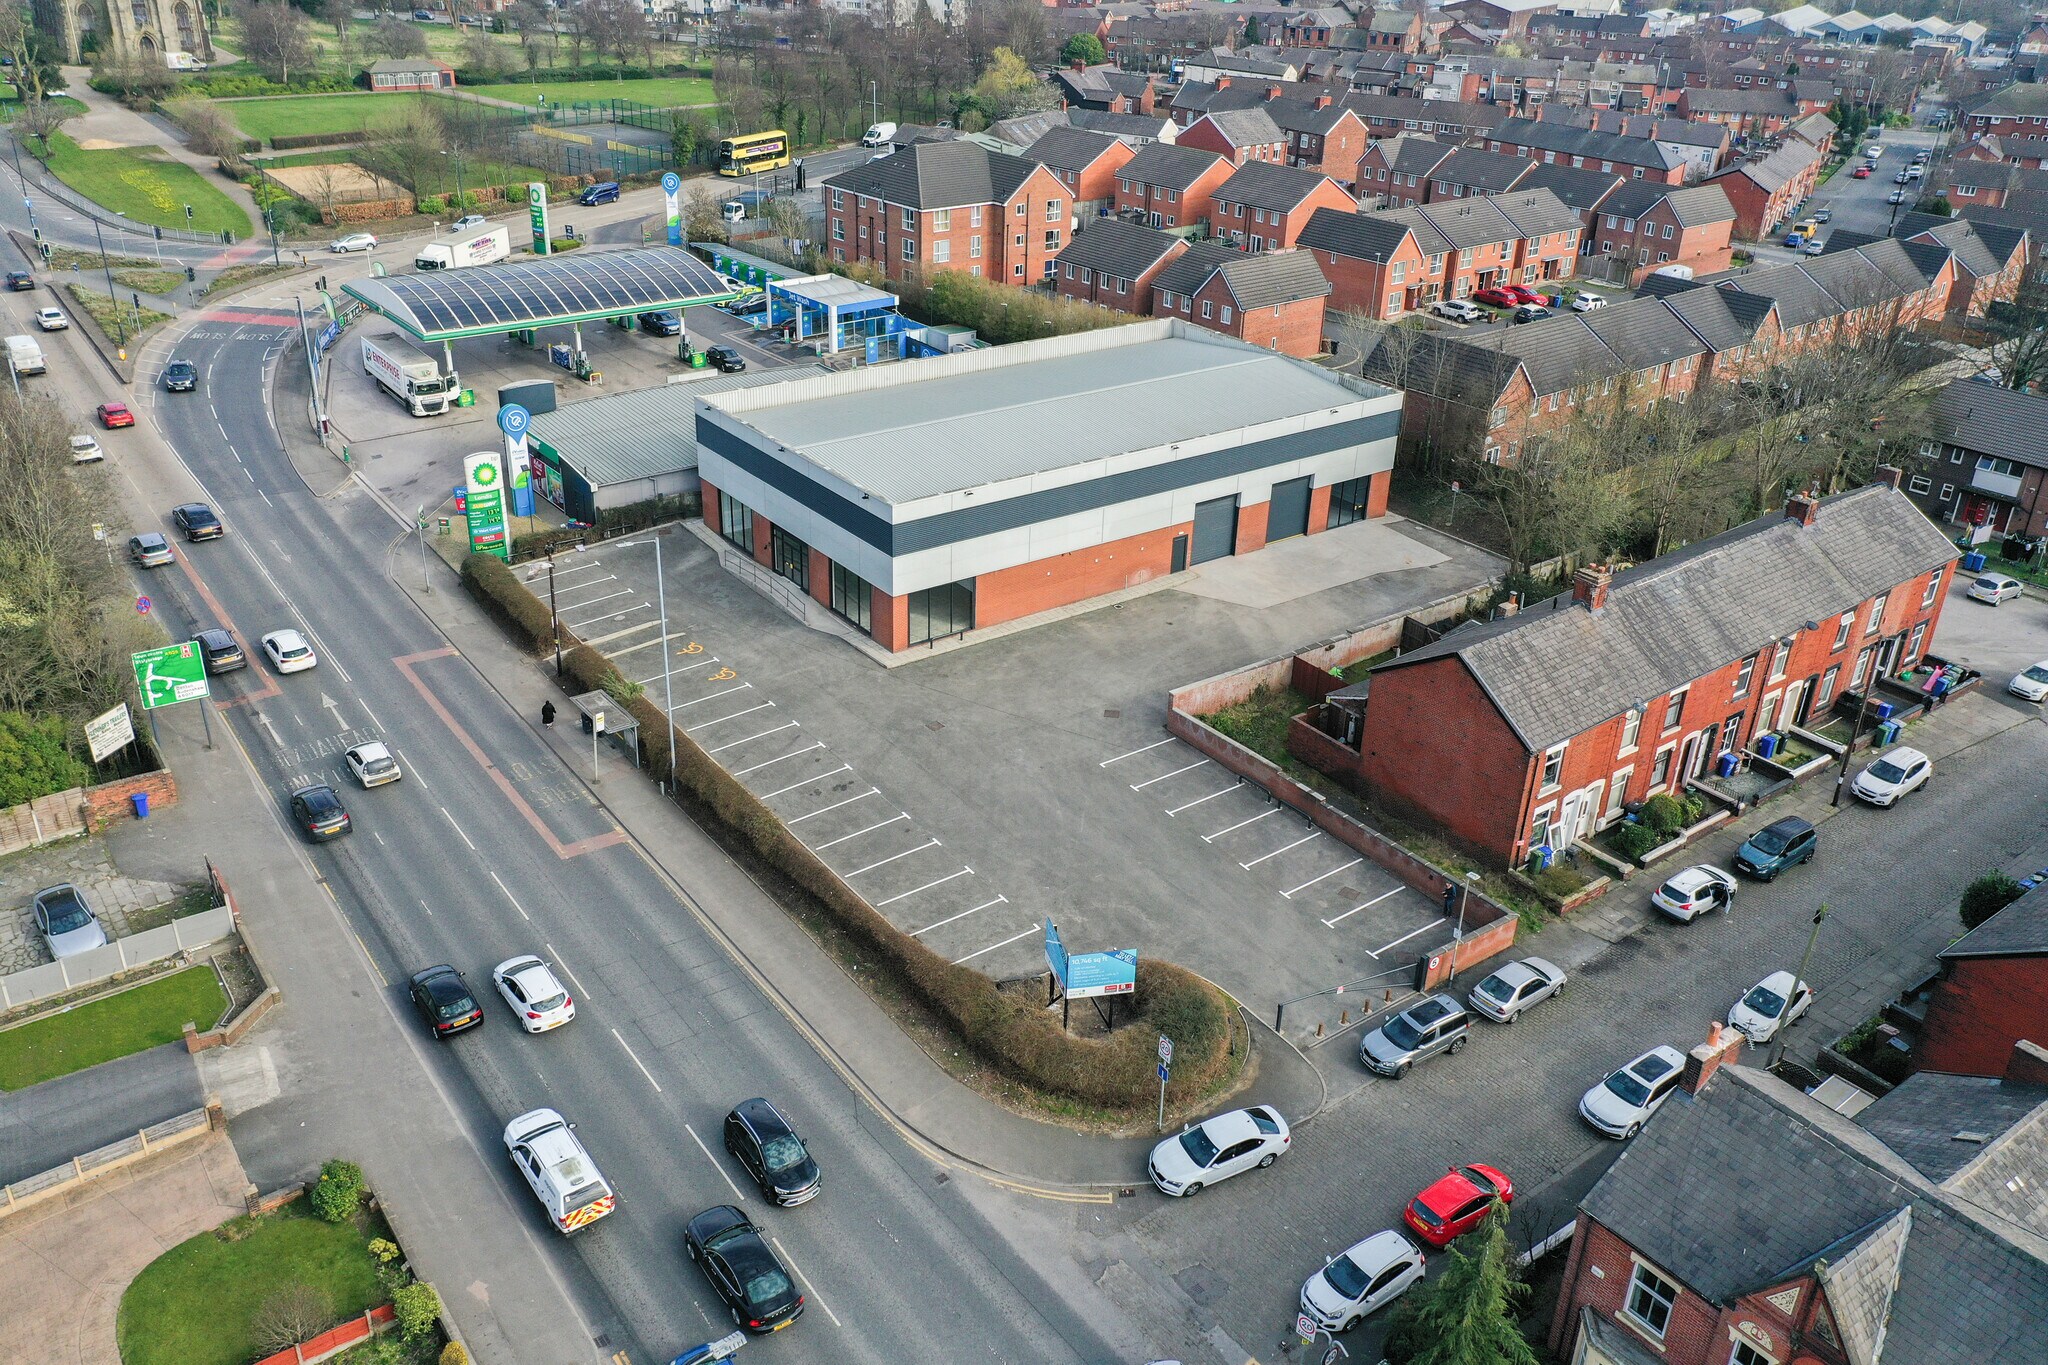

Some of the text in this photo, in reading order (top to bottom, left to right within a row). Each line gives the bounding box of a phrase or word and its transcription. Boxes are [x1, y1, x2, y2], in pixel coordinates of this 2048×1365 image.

[372, 351, 400, 380] ENTERPRISE
[474, 493, 493, 501] Londis
[472, 500, 497, 509] SUBWAY
[110, 711, 127, 724] TRAILERS
[1432, 959, 1437, 967] 5
[1161, 1043, 1169, 1052] 20
[1301, 1320, 1313, 1331] 20
[1298, 1329, 1312, 1340] ZONE
